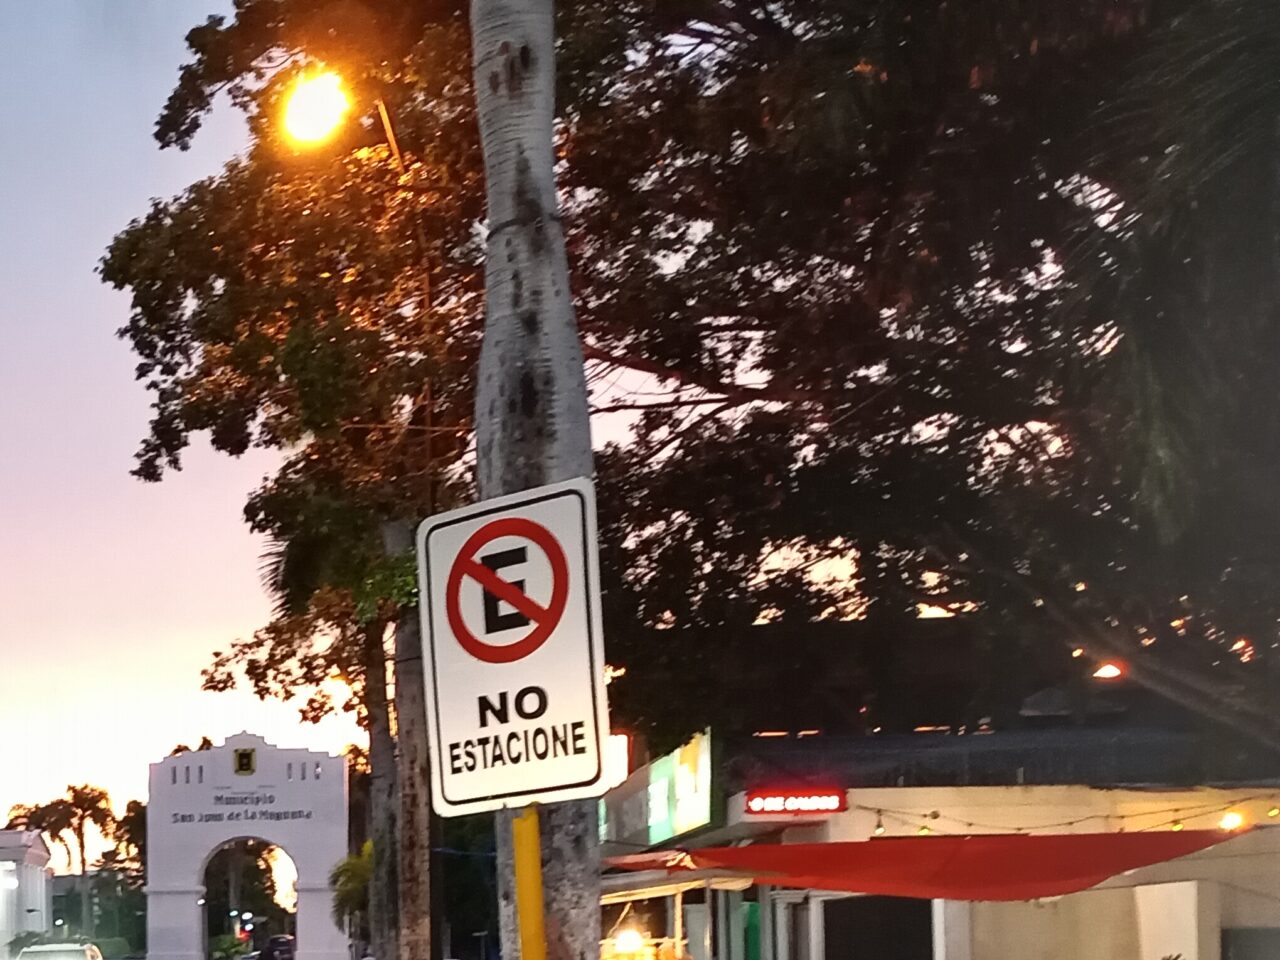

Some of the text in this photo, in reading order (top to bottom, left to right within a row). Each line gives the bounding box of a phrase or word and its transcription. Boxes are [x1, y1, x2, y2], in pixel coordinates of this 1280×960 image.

[481, 546, 530, 635] E
[477, 685, 549, 729] NO
[449, 720, 587, 775] ESTACIONE
[171, 812, 195, 824] San
[197, 812, 224, 823] Juan
[226, 810, 242, 821] de
[213, 793, 276, 807] Municipio
